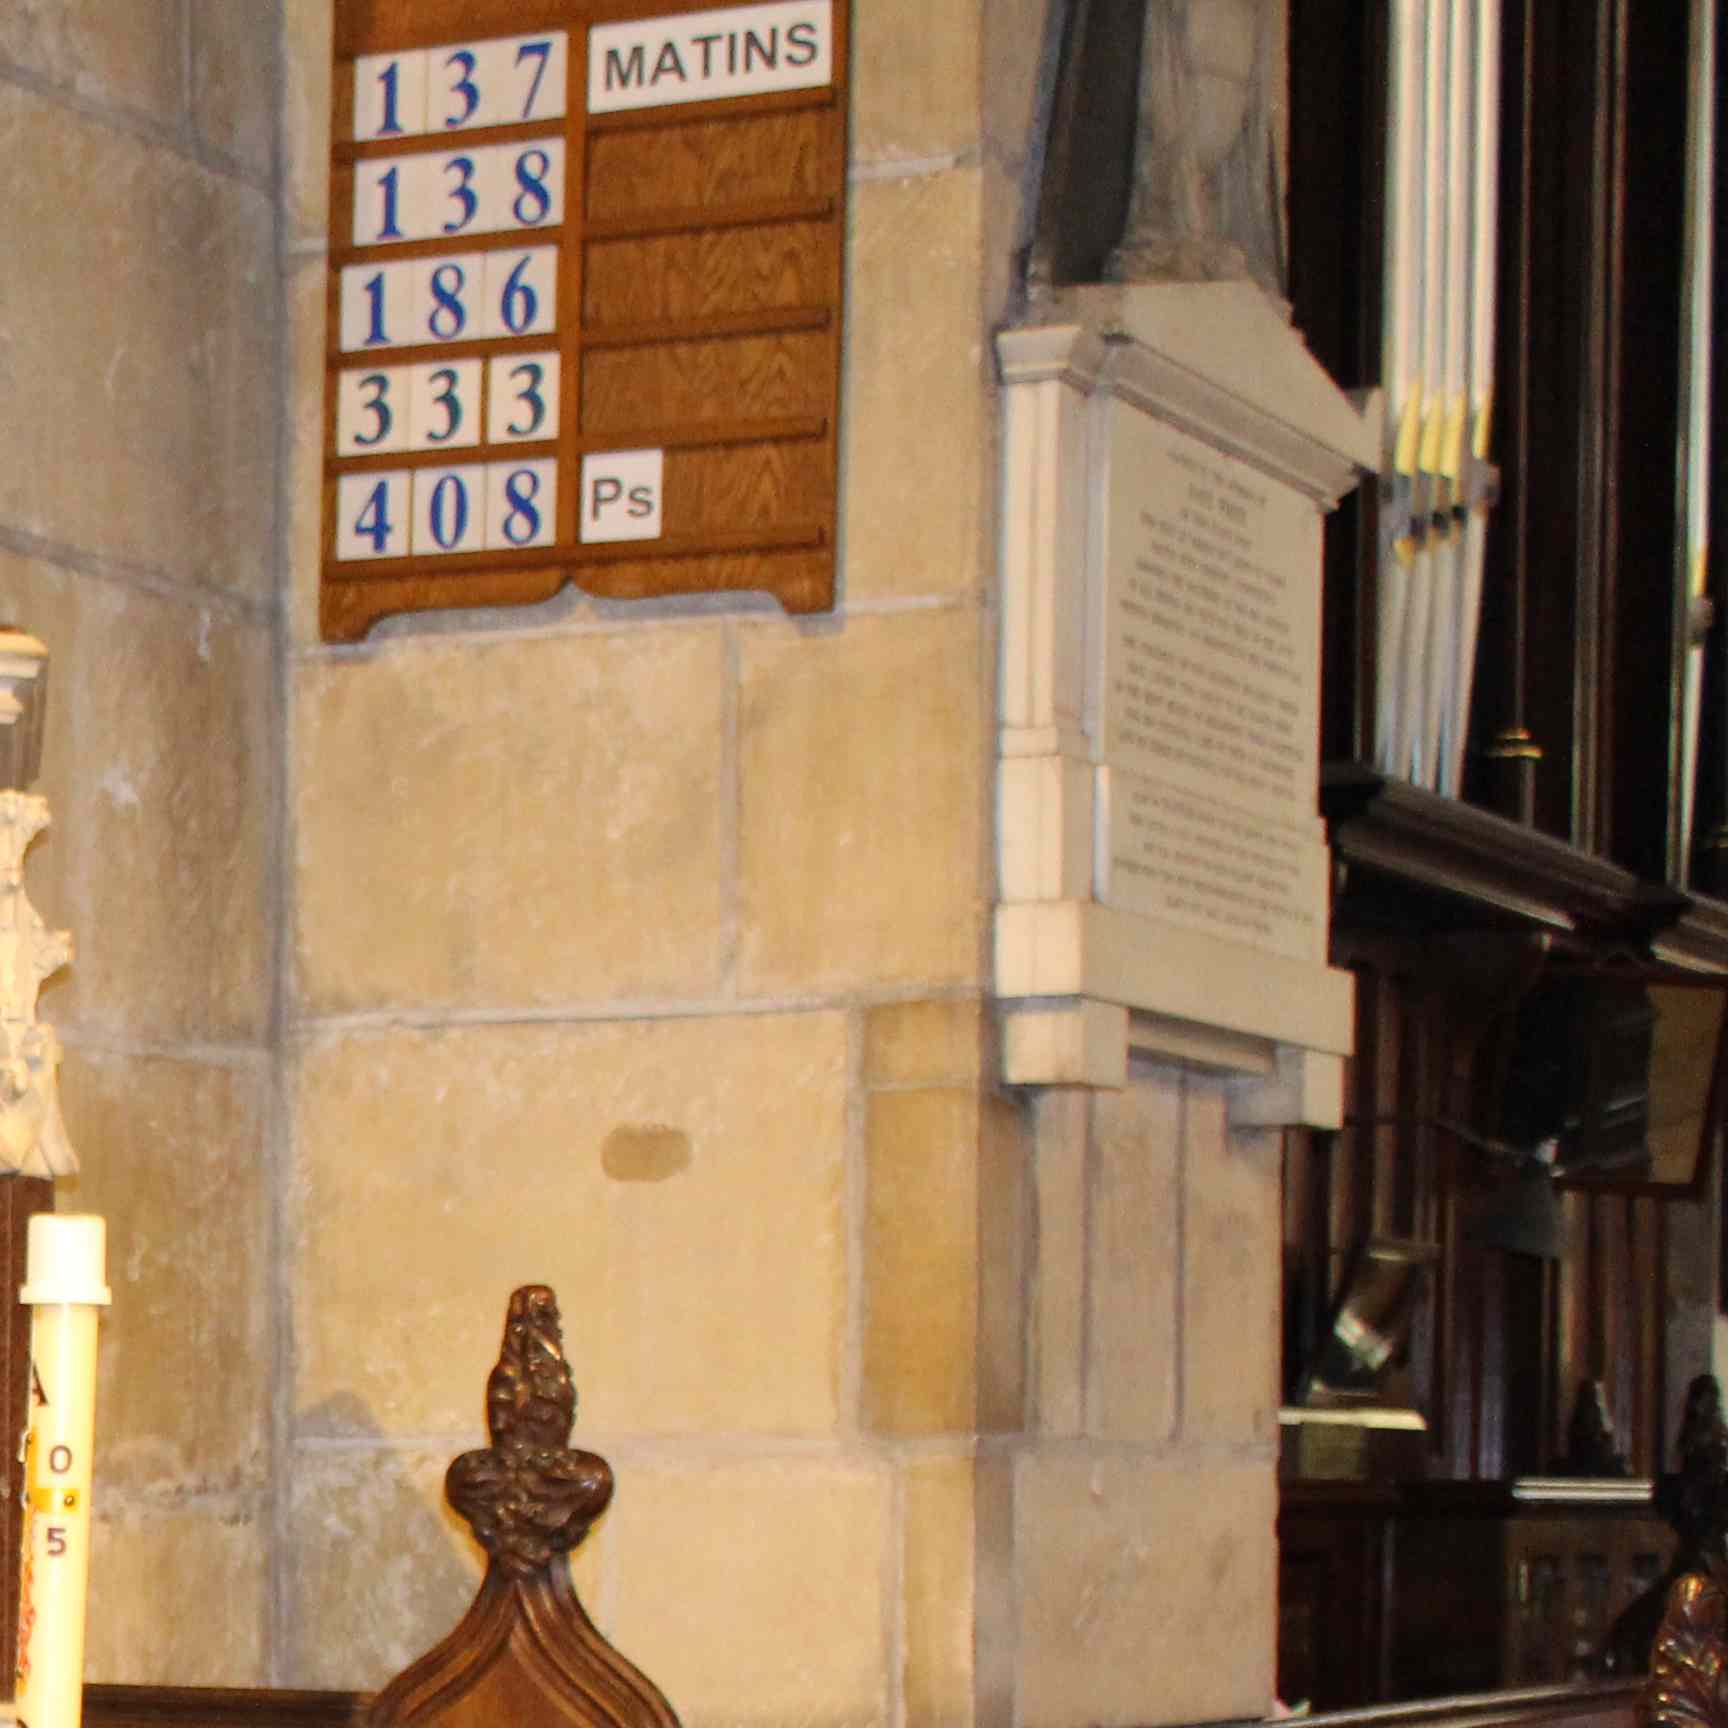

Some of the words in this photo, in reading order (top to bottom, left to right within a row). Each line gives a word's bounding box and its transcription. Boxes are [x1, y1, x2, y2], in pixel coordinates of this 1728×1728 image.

[375, 40, 554, 136] 137
[604, 22, 819, 92] MATINS
[376, 149, 552, 241] 138
[363, 255, 539, 346] 186
[353, 362, 545, 446] 333
[354, 469, 542, 554] 408
[592, 477, 655, 520] Ps
[46, 1527, 68, 1557] 5
